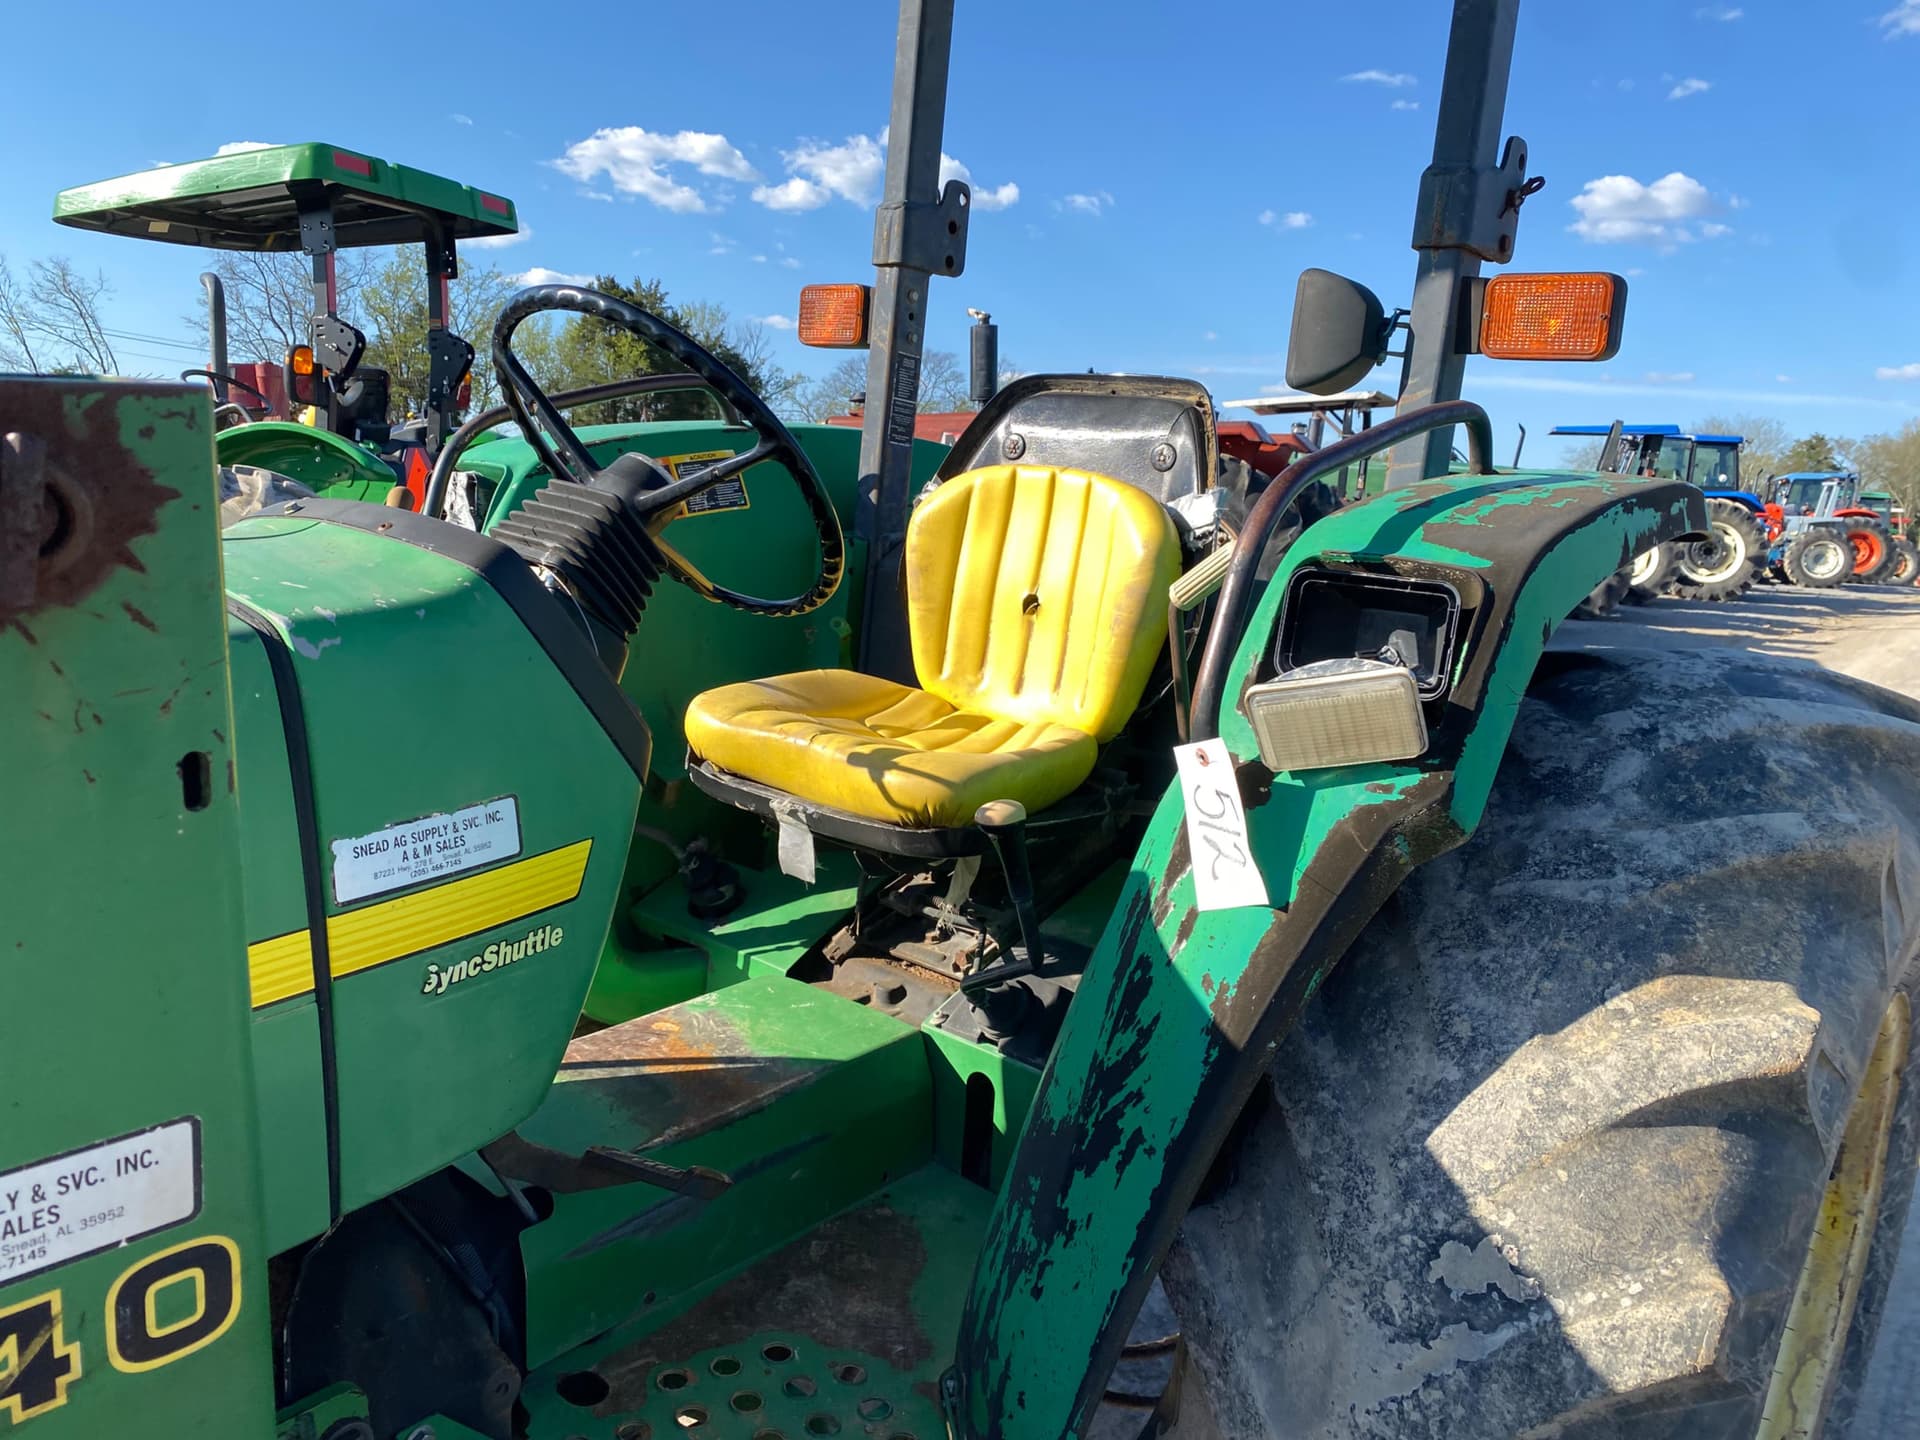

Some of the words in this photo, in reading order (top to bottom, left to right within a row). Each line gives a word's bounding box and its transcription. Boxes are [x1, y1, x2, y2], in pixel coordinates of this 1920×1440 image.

[353, 839, 389, 859] SNEAD
[393, 834, 407, 849] AG
[411, 824, 448, 844] SUPPLY
[452, 821, 459, 833] &
[462, 816, 483, 831] SVC.
[485, 810, 503, 825] INC.
[402, 850, 409, 863] A
[413, 847, 420, 859] &
[423, 843, 432, 855] M
[436, 835, 466, 853] SALES
[1194, 785, 1247, 880] 512
[423, 925, 564, 995] SyncShuttle
[32, 1184, 47, 1204] &
[57, 1166, 105, 1195] SVC.
[116, 1149, 160, 1177] INC.
[2, 1204, 61, 1241] ALES
[56, 1224, 74, 1237] AL
[79, 1206, 125, 1231] 35952
